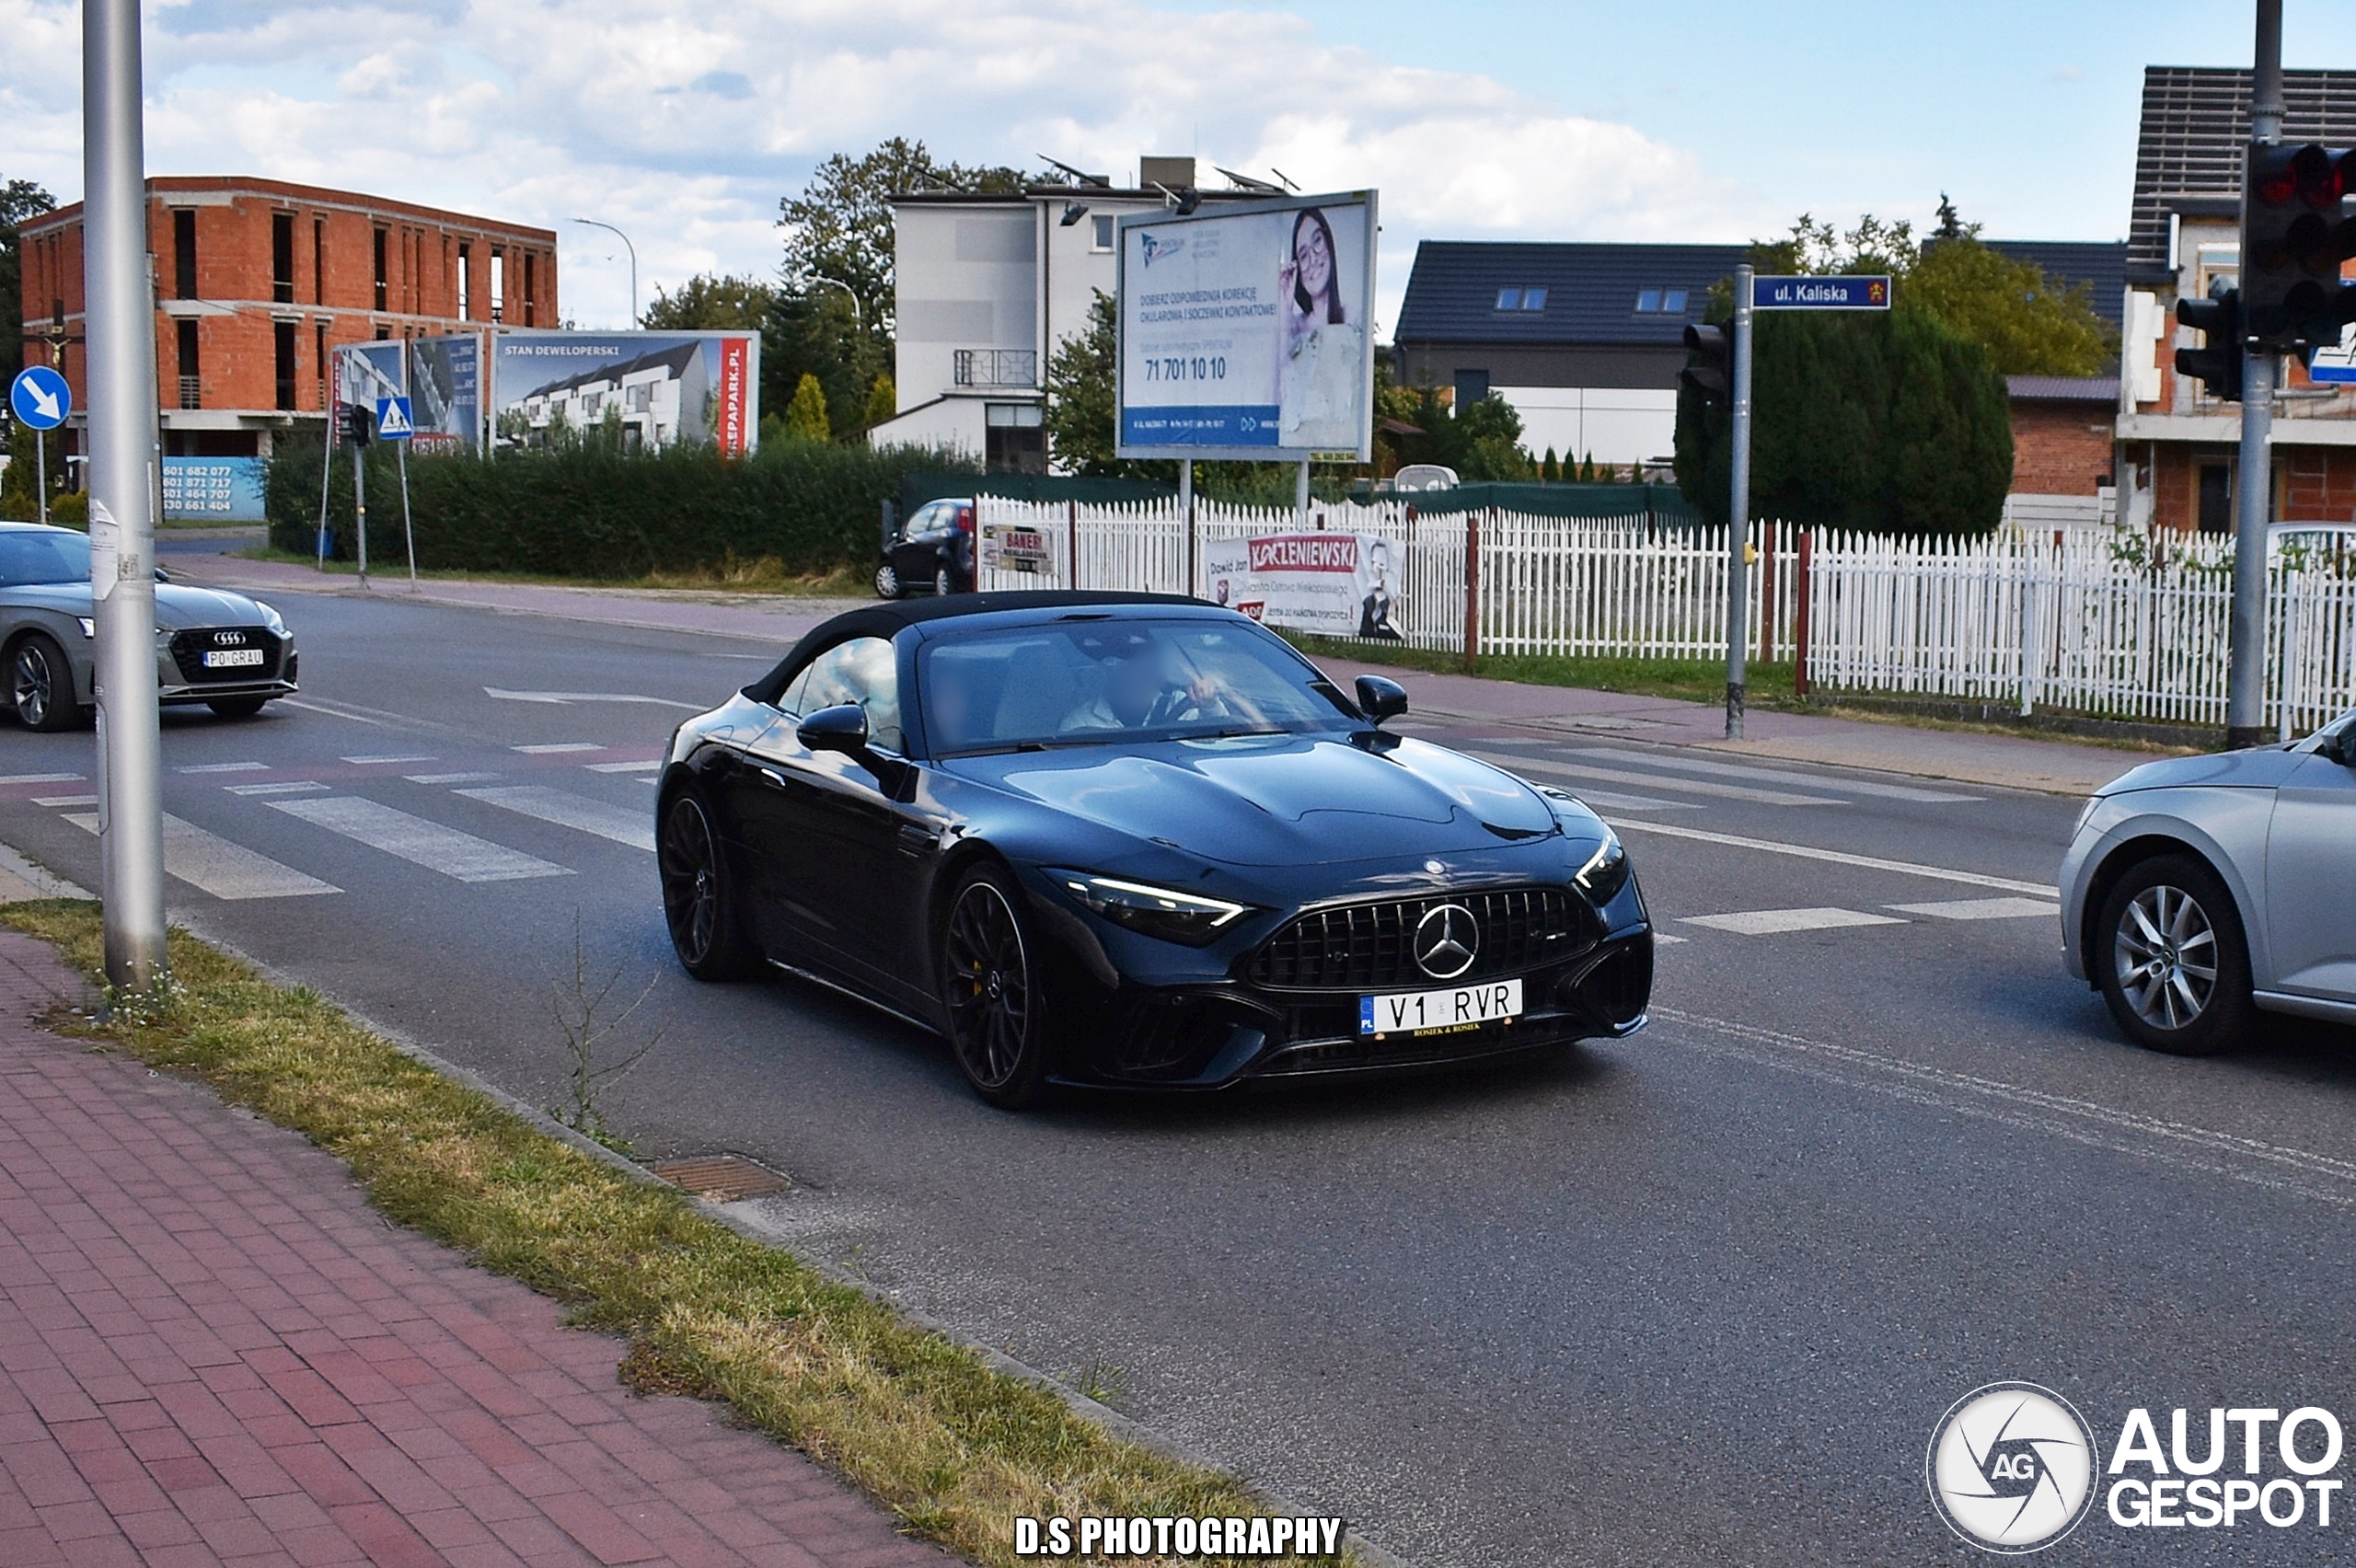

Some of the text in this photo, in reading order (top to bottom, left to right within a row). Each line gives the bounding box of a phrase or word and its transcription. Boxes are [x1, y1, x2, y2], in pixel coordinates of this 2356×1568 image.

[1774, 284, 1848, 301] ul. Kaliska
[504, 345, 619, 355] STAN DEWELOPERSKI
[1146, 356, 1226, 381] 71 701 10 10
[187, 467, 208, 476] 682
[210, 467, 231, 476] 077
[210, 478, 231, 488] 717
[185, 489, 207, 499] 464
[210, 489, 231, 499] 707
[185, 501, 206, 511] 661
[209, 501, 231, 511] 404
[1252, 541, 1357, 569] KORZENIEWSKI
[210, 651, 261, 665] PO GRAU
[1390, 986, 1509, 1028] V1 RVR
[1361, 1020, 1373, 1029] PL
